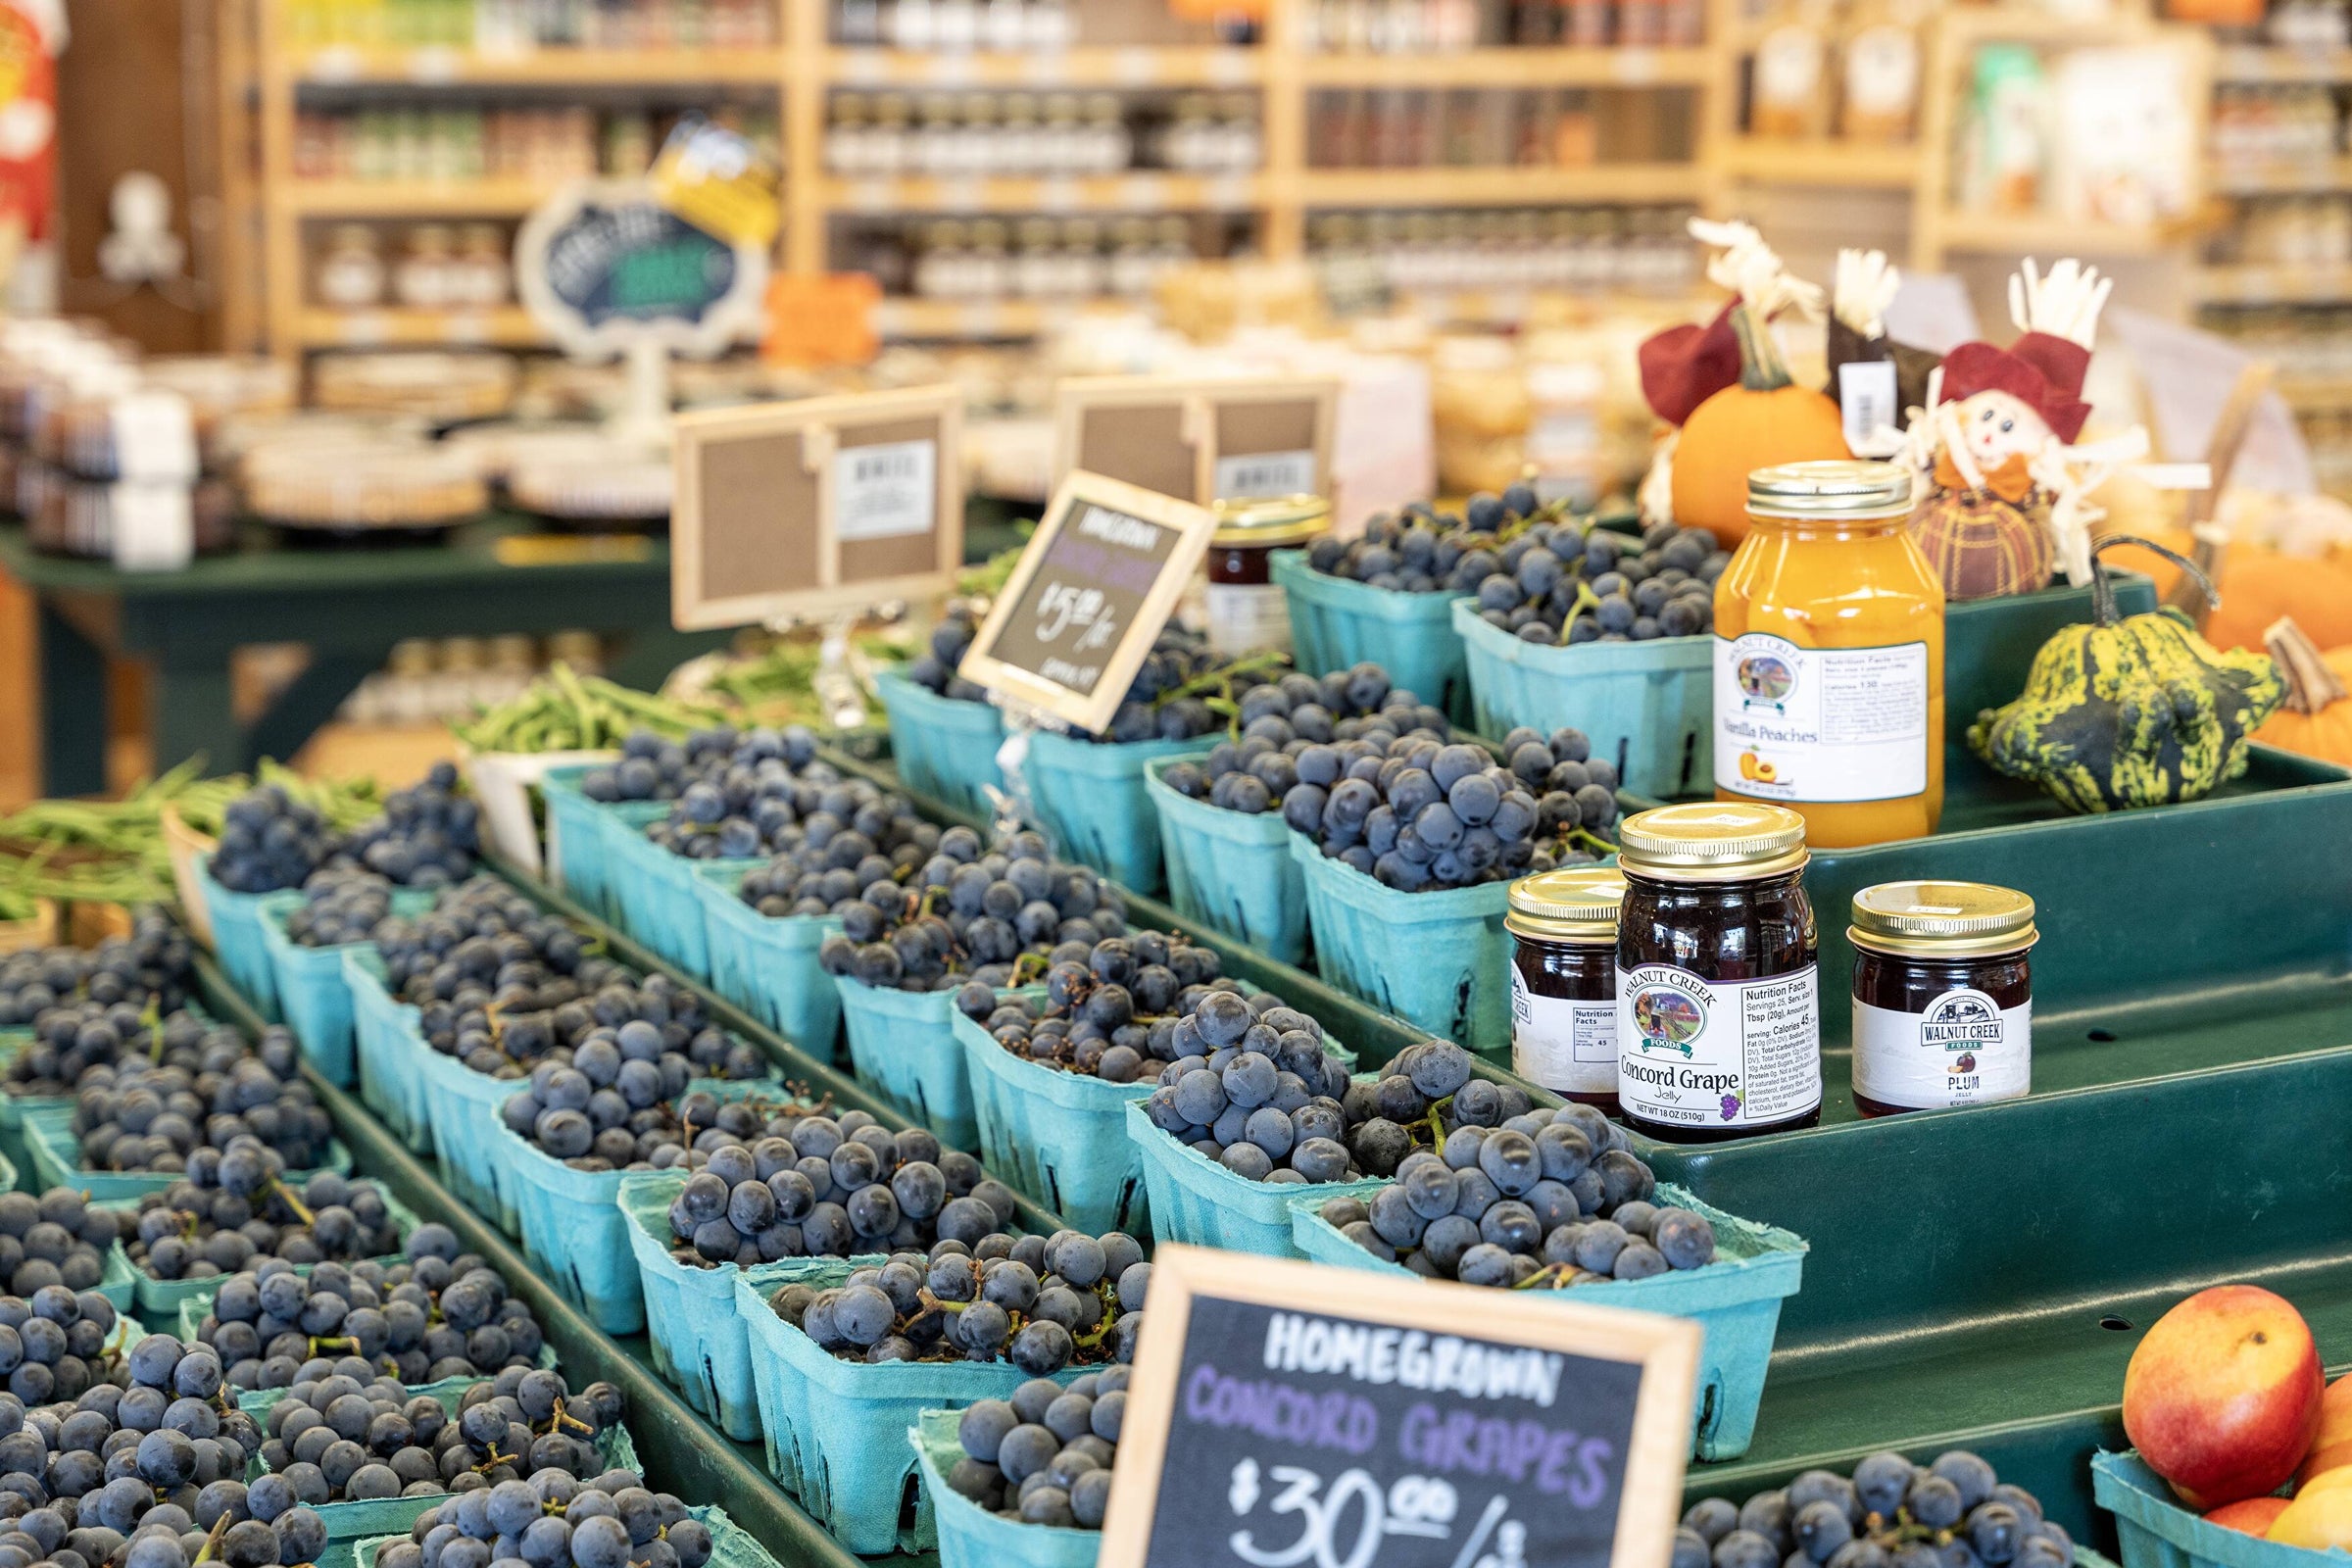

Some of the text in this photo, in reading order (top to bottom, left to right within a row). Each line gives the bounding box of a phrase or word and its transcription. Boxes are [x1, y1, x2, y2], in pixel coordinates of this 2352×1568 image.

[1759, 725, 1818, 743] Peaches
[1625, 970, 1717, 1008] WALNUT CREEK
[1746, 981, 1807, 1001] Nutrition Facts
[1746, 1001, 1776, 1011] Servings
[1777, 998, 1787, 1007] 25,
[1746, 1013, 1765, 1023] Tbsp
[1787, 1004, 1804, 1016] Amount
[1773, 1022, 1800, 1035] Calories
[1925, 1024, 2000, 1041] WALNUT CREEK
[1650, 1039, 1682, 1050] FOODS
[1776, 1039, 1805, 1052] Carbohydrate
[1622, 1055, 1740, 1095] Concord Grape
[1755, 1078, 1780, 1087] saturated
[1948, 1076, 1979, 1090] PLUM
[1654, 1086, 1682, 1104] Jelly
[1748, 1087, 1779, 1097] cholesterol,
[1637, 1103, 1647, 1113] NET
[1669, 1110, 1680, 1119] OZ
[1681, 1112, 1705, 1123] (510g)
[1263, 1312, 1565, 1407] HOMEGROWN
[1186, 1364, 1614, 1509] CONCORD GRAPES
